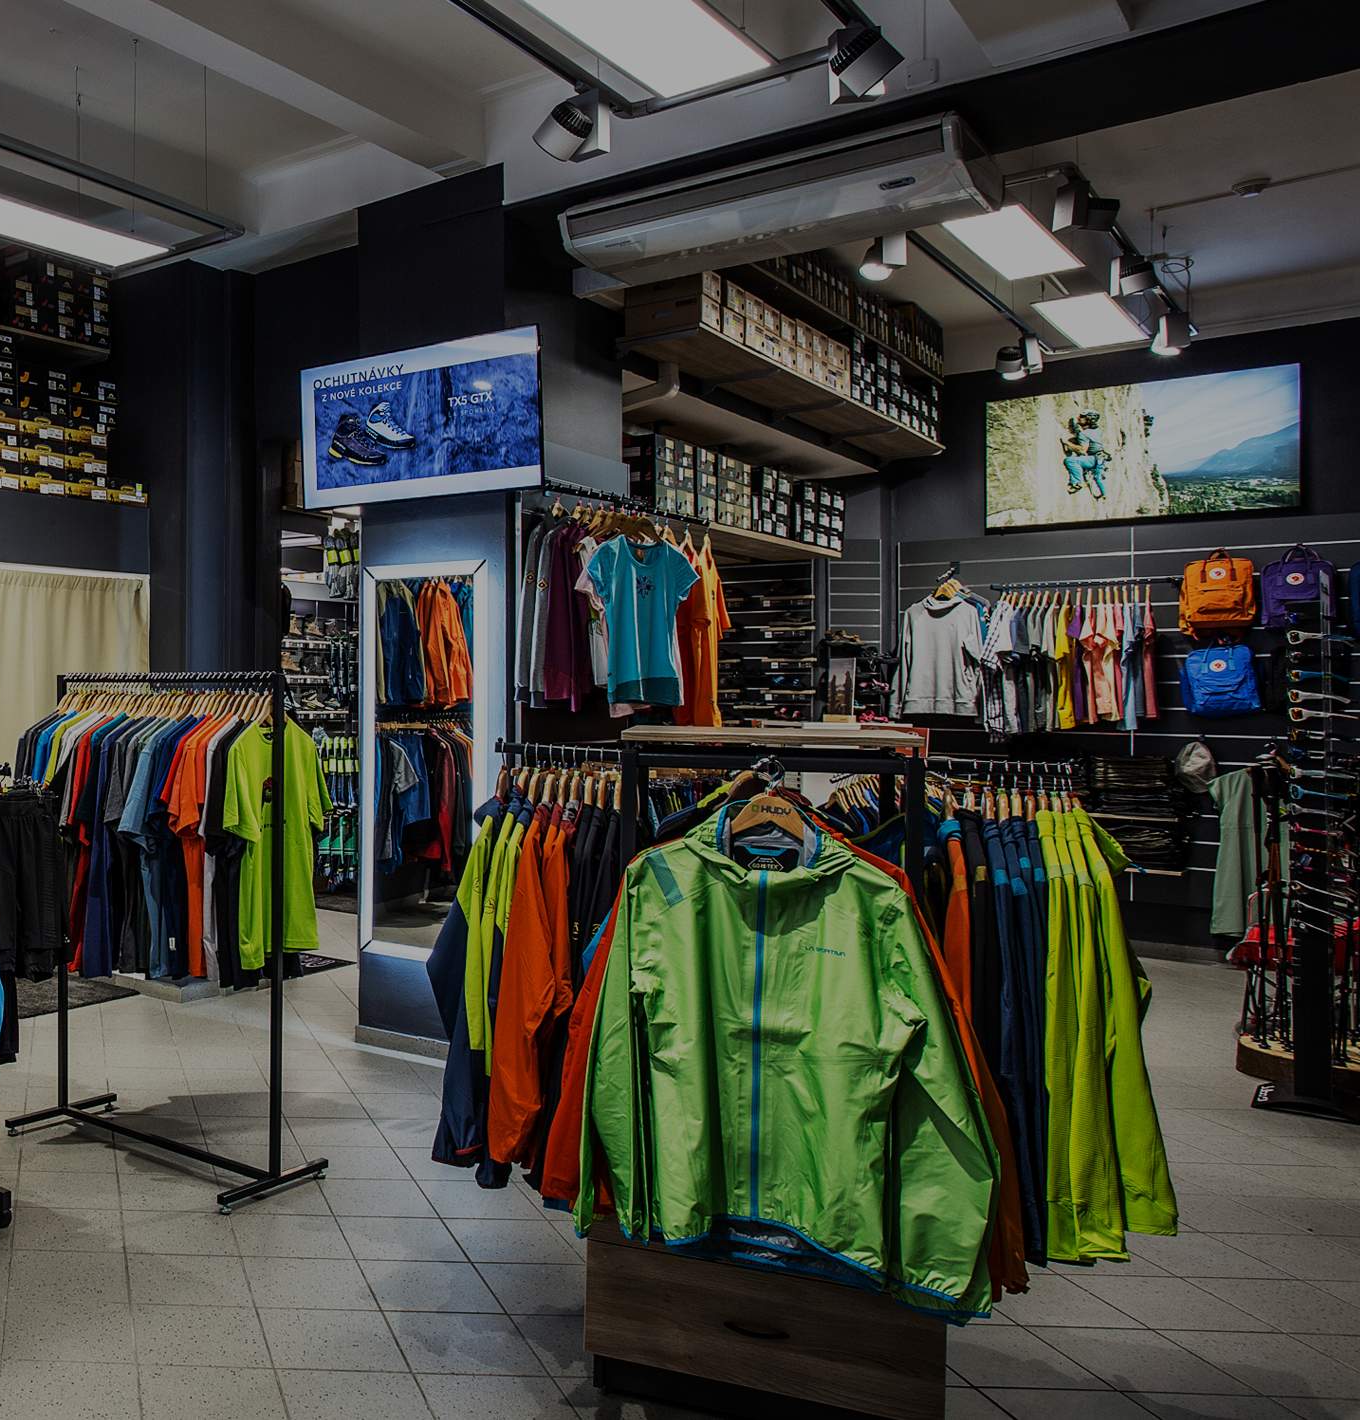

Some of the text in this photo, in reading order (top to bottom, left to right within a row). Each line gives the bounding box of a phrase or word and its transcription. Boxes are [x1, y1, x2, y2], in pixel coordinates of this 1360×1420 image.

[313, 364, 404, 390] OCHUTNÁVKY
[321, 380, 402, 402] Z NOVÉ KOLEKCE
[447, 391, 493, 407] TX5 GTX
[760, 805, 791, 815] HUDY
